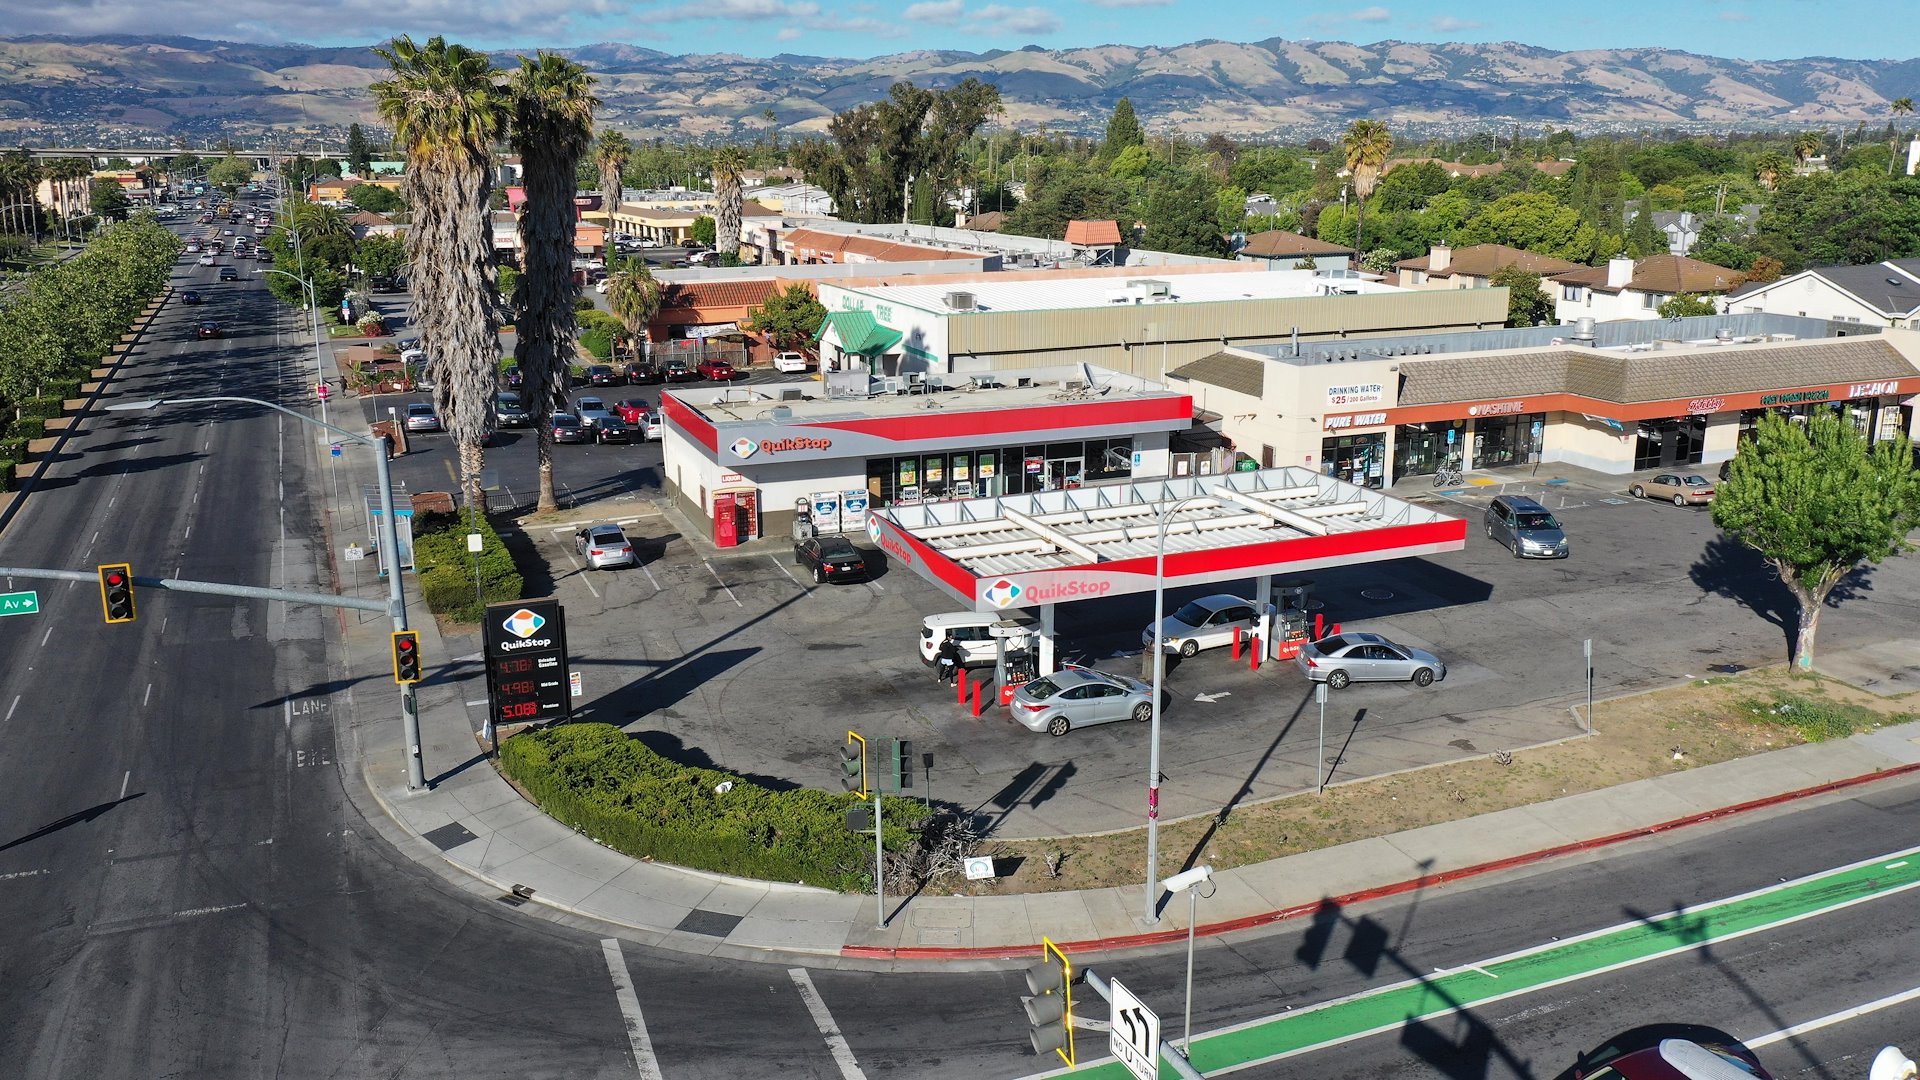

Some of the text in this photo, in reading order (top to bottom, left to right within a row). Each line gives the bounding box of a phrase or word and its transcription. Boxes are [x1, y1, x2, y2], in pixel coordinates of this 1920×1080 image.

[842, 295, 892, 322] DOLLAR TREE
[1328, 384, 1380, 396] DRINKING WATER
[1325, 412, 1387, 429] PURE WATER
[760, 437, 832, 455] QuikStop
[880, 532, 912, 567] QuikStop
[1025, 580, 1111, 604] QuikStop
[4, 599, 19, 610] Av
[501, 638, 551, 652] QuikStop
[1113, 1036, 1123, 1053] NO
[1125, 1046, 1133, 1063] U
[1135, 1058, 1154, 1080] TURN
